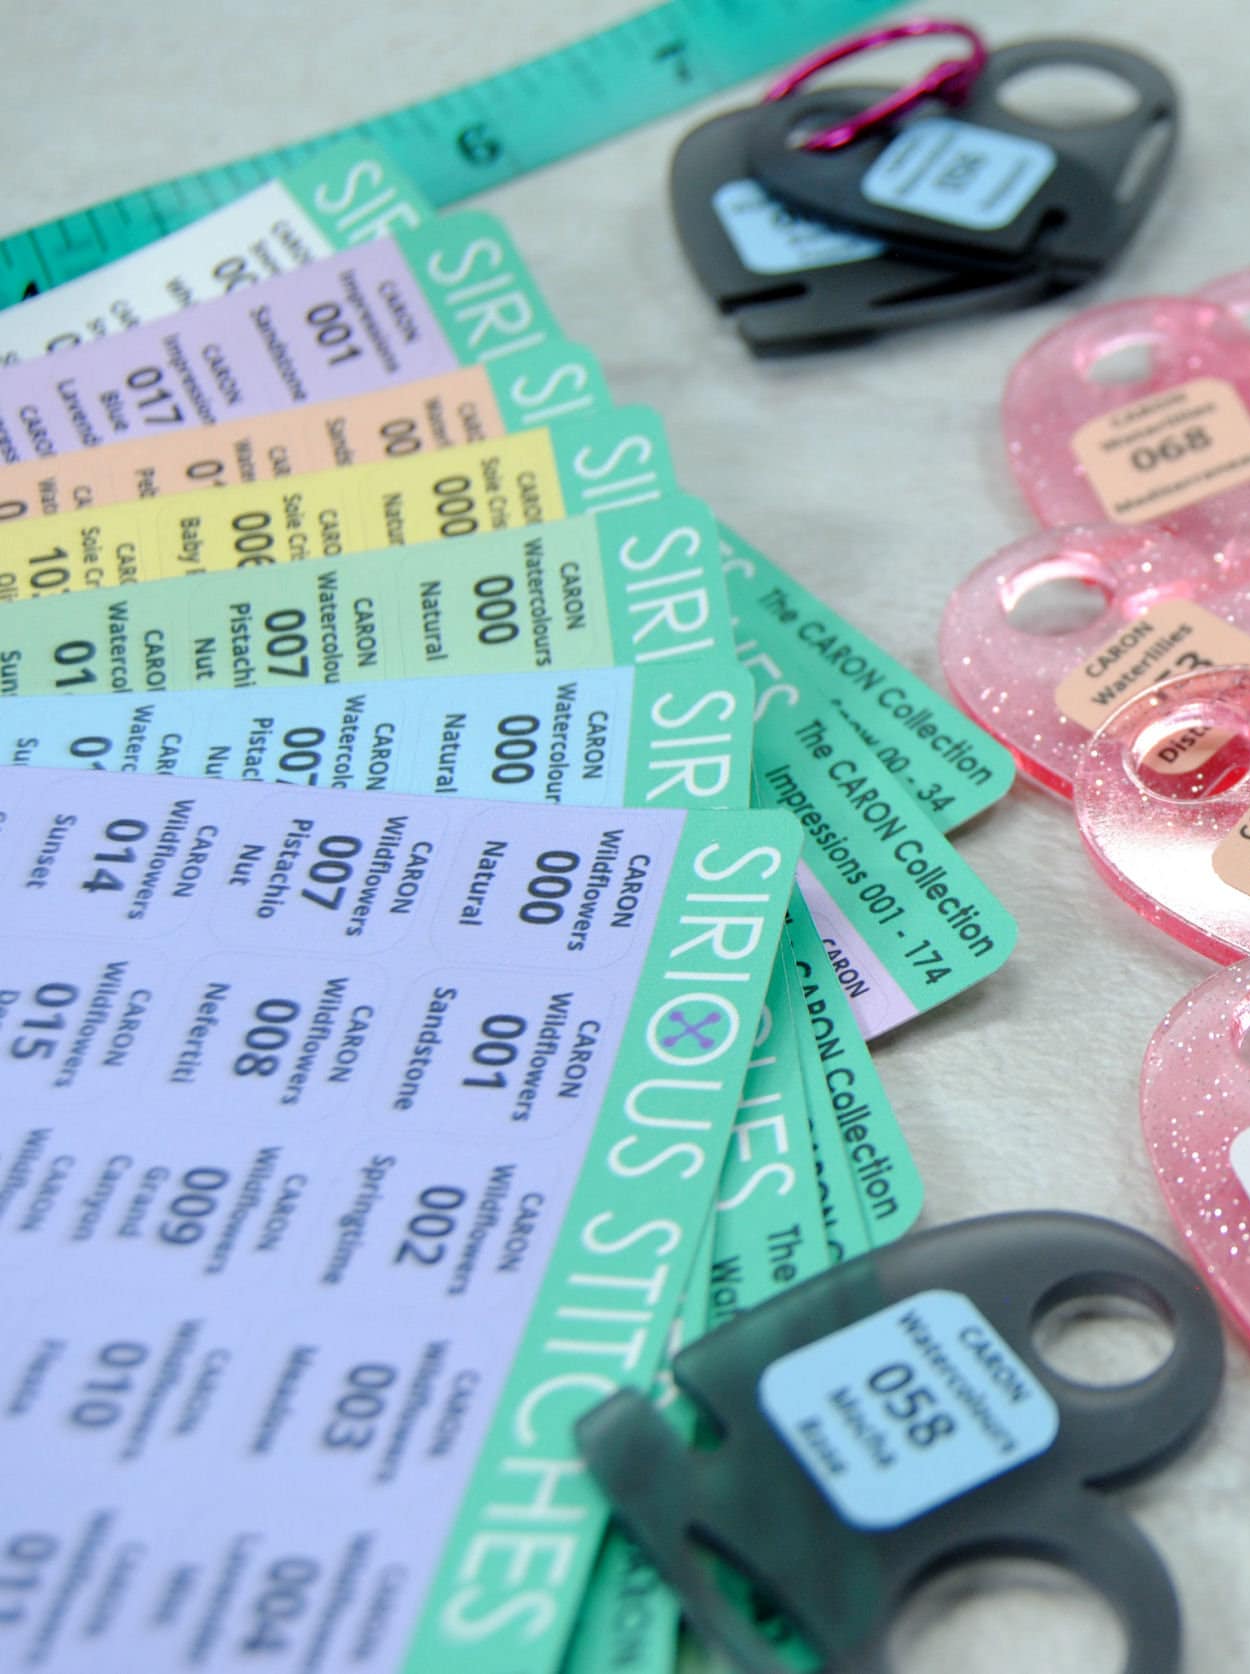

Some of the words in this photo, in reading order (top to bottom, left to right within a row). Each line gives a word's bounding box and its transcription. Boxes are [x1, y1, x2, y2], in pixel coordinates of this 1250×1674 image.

[306, 302, 363, 367] 001
[125, 366, 185, 425] 017
[1130, 425, 1213, 473] 068
[432, 474, 480, 539] 000
[353, 597, 377, 667] CARON
[419, 580, 449, 662] Natural
[473, 574, 520, 645] 000
[522, 537, 552, 668] Watercolours
[559, 561, 587, 630] CARON
[143, 629, 167, 692] CARO
[194, 637, 217, 681] Nut
[264, 607, 310, 679] 007
[1085, 620, 1154, 678] CARON
[1091, 623, 1194, 707] Waterlilies
[759, 586, 798, 624] The
[797, 620, 885, 692] CARON
[878, 687, 993, 787] Collection
[365, 722, 396, 790] CARON
[434, 713, 467, 794] Natural
[491, 714, 541, 785] 000
[582, 710, 609, 780] CARON
[917, 782, 957, 812] 34
[25, 813, 77, 889] Sunset
[81, 818, 149, 893] 014
[127, 799, 196, 920] Wildflowers
[172, 825, 219, 898] CARON
[228, 844, 266, 886] Nut
[256, 818, 314, 919] Pistachio
[301, 834, 363, 911] 007
[346, 815, 409, 936] Wildflowers
[390, 841, 433, 914] CARON
[764, 764, 868, 885] Impressions
[858, 883, 906, 926] 001
[904, 939, 953, 985] 174
[794, 719, 833, 760] The
[828, 758, 908, 843] CARON
[893, 839, 995, 958] Collection
[459, 840, 508, 926] Natural
[518, 850, 581, 925] 000
[567, 828, 624, 952] Wildflowers
[610, 854, 651, 928] CARON
[10, 982, 79, 1060] 015
[53, 960, 130, 1088] Wildflowers
[101, 988, 152, 1067] CARON
[171, 982, 232, 1083] Nefertiti
[232, 998, 301, 1077] 008
[280, 976, 349, 1105] Wildflowers
[328, 1004, 374, 1083] CARON
[394, 986, 458, 1111] Sandstone
[607, 841, 782, 1180] SIRIOUS
[461, 1013, 528, 1090] 001
[511, 991, 574, 1122] Wildflowers
[557, 1019, 601, 1099] CARON
[826, 1067, 899, 1220] Collection
[158, 1166, 230, 1246] 009
[203, 1146, 283, 1276] Wildflowers
[254, 1173, 308, 1251] CARON
[320, 1153, 397, 1285] Springtime
[392, 1185, 467, 1266] 002
[446, 1163, 517, 1297] Wildflowers
[496, 1191, 545, 1273] CARON
[767, 1224, 801, 1284] The
[69, 1341, 149, 1429] 010
[958, 1325, 1031, 1404] CARON
[321, 1361, 398, 1452] 003
[437, 1211, 684, 1645] STITCHES
[867, 1362, 957, 1447] 058
